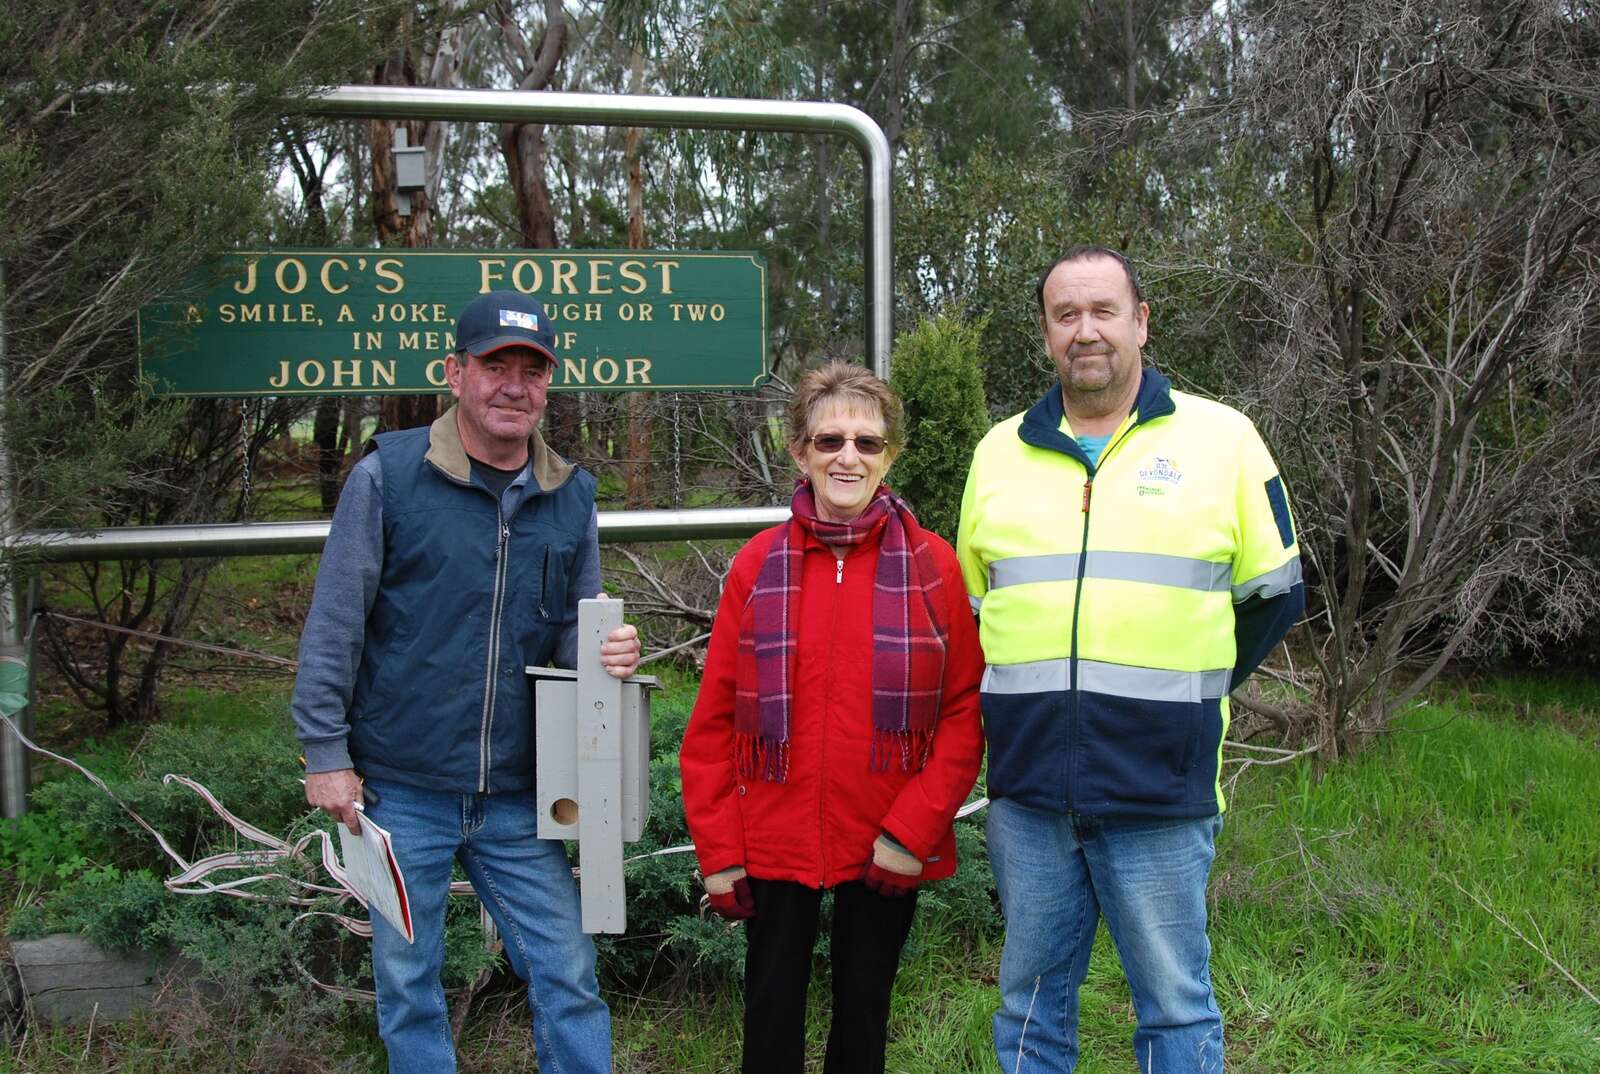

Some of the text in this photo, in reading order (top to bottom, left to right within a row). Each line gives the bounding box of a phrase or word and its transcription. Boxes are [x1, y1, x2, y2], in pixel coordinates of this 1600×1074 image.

[234, 258, 680, 295] JOC'S FOREST
[187, 304, 203, 323] A
[219, 303, 323, 326] SMILE,
[337, 304, 354, 322] A
[372, 303, 456, 326] JOKE,
[618, 303, 653, 322] OR
[670, 303, 726, 322] TWO
[353, 332, 383, 350] IN
[269, 359, 396, 387] JOHN
